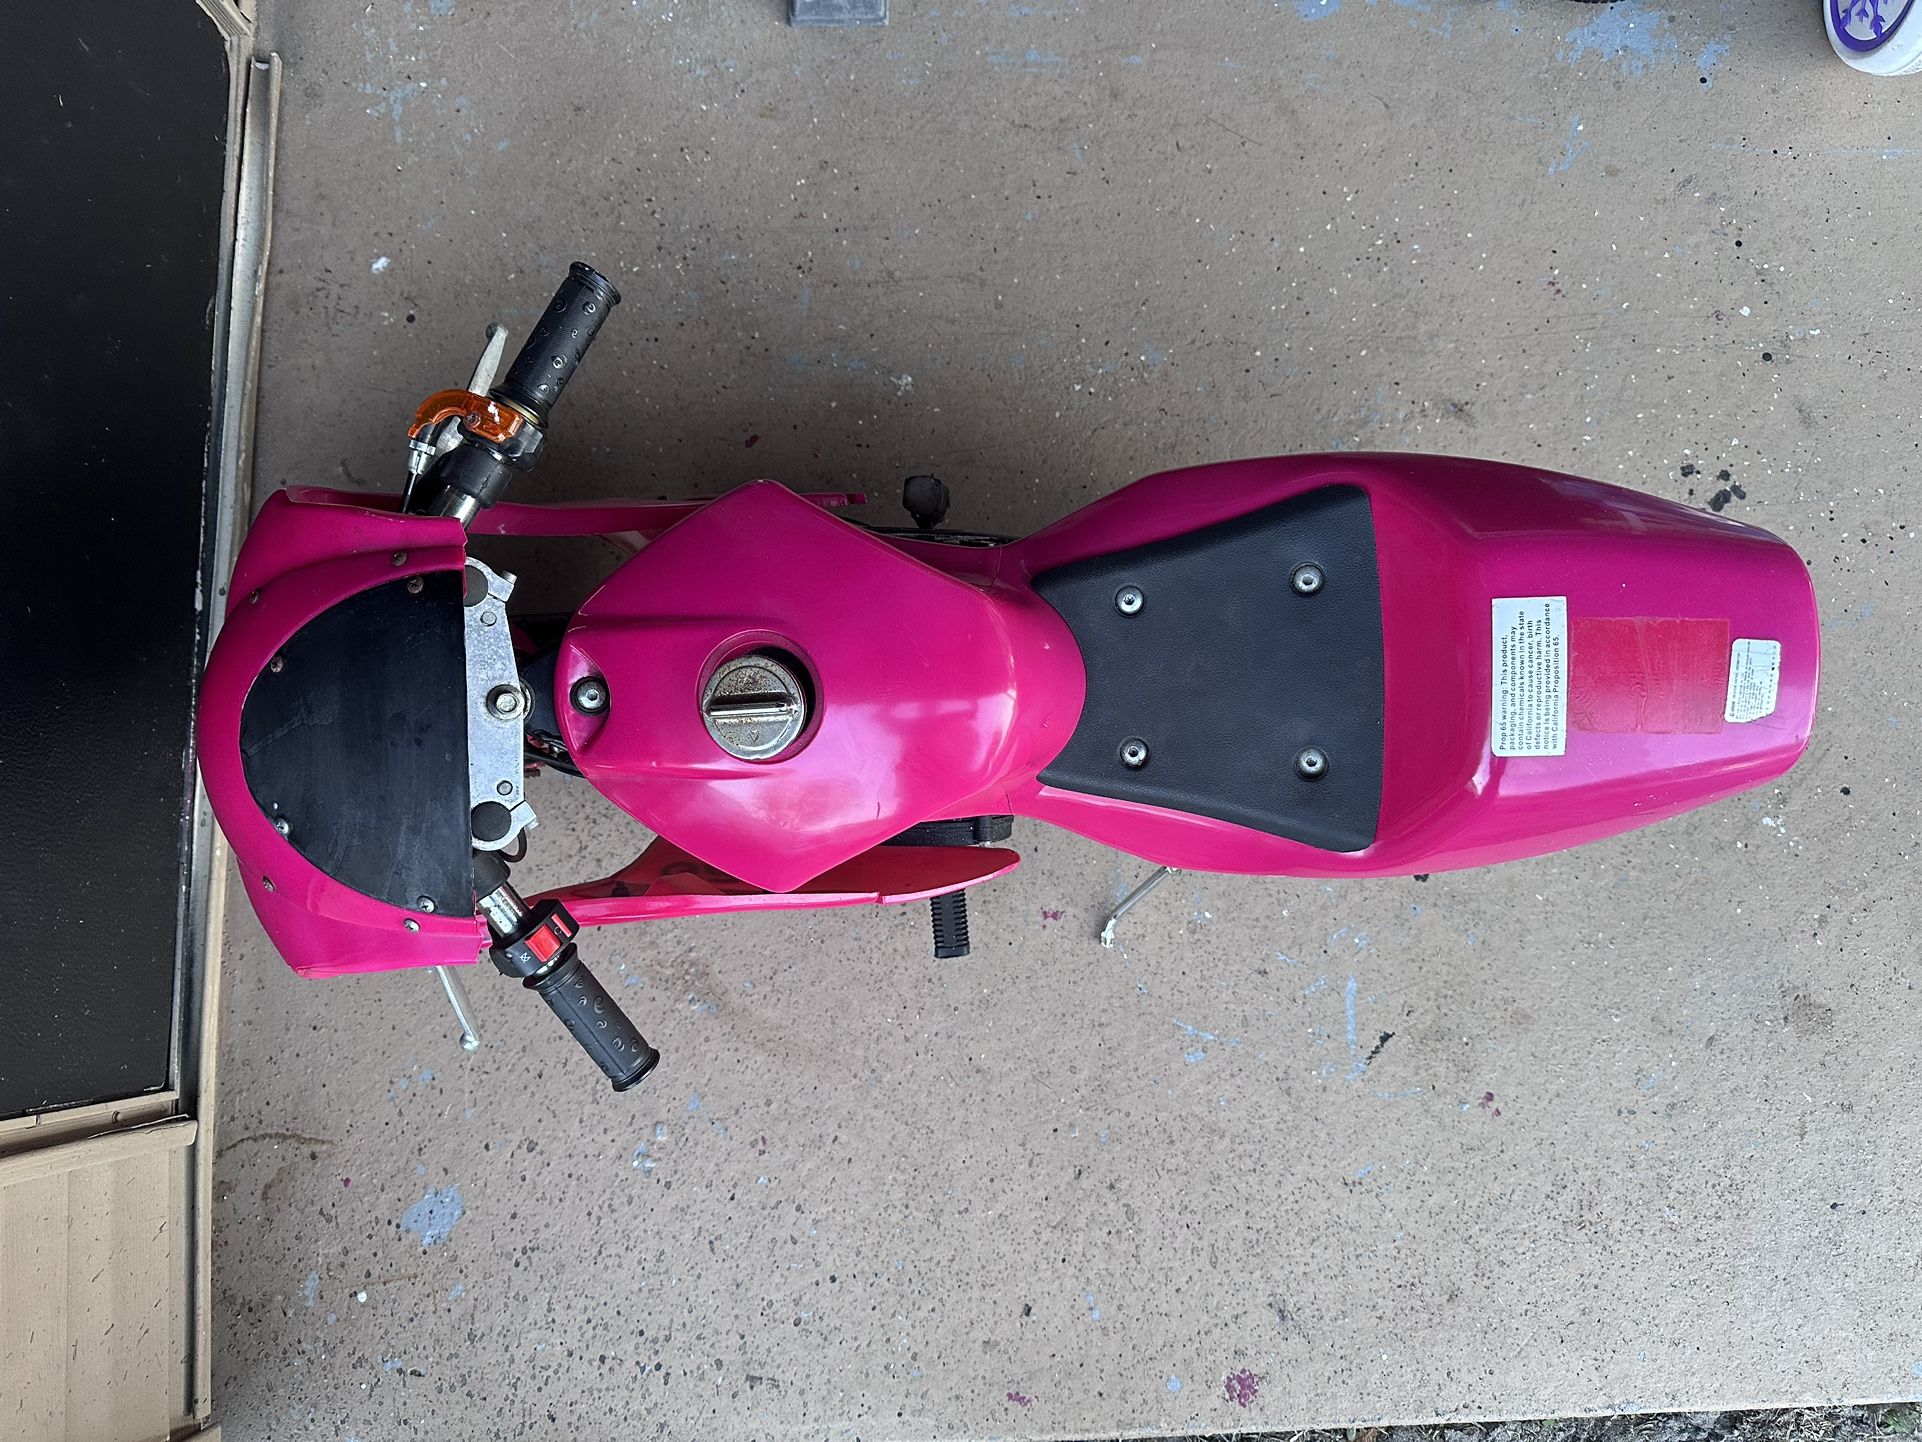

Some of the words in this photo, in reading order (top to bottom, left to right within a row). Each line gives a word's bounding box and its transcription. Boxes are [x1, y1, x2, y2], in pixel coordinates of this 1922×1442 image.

[1501, 634, 1509, 667] product,
[1519, 645, 1525, 653] in
[1545, 649, 1551, 657] in
[1544, 658, 1552, 693] provided
[1553, 647, 1561, 693] Proposition
[1535, 661, 1543, 711] reproductive
[1527, 694, 1533, 702] to
[1544, 694, 1552, 716] being
[1536, 712, 1541, 721] or
[1500, 721, 1506, 731] 65
[1509, 708, 1517, 750] packaging,
[1499, 732, 1507, 750] Prop
[1526, 741, 1532, 750] of
